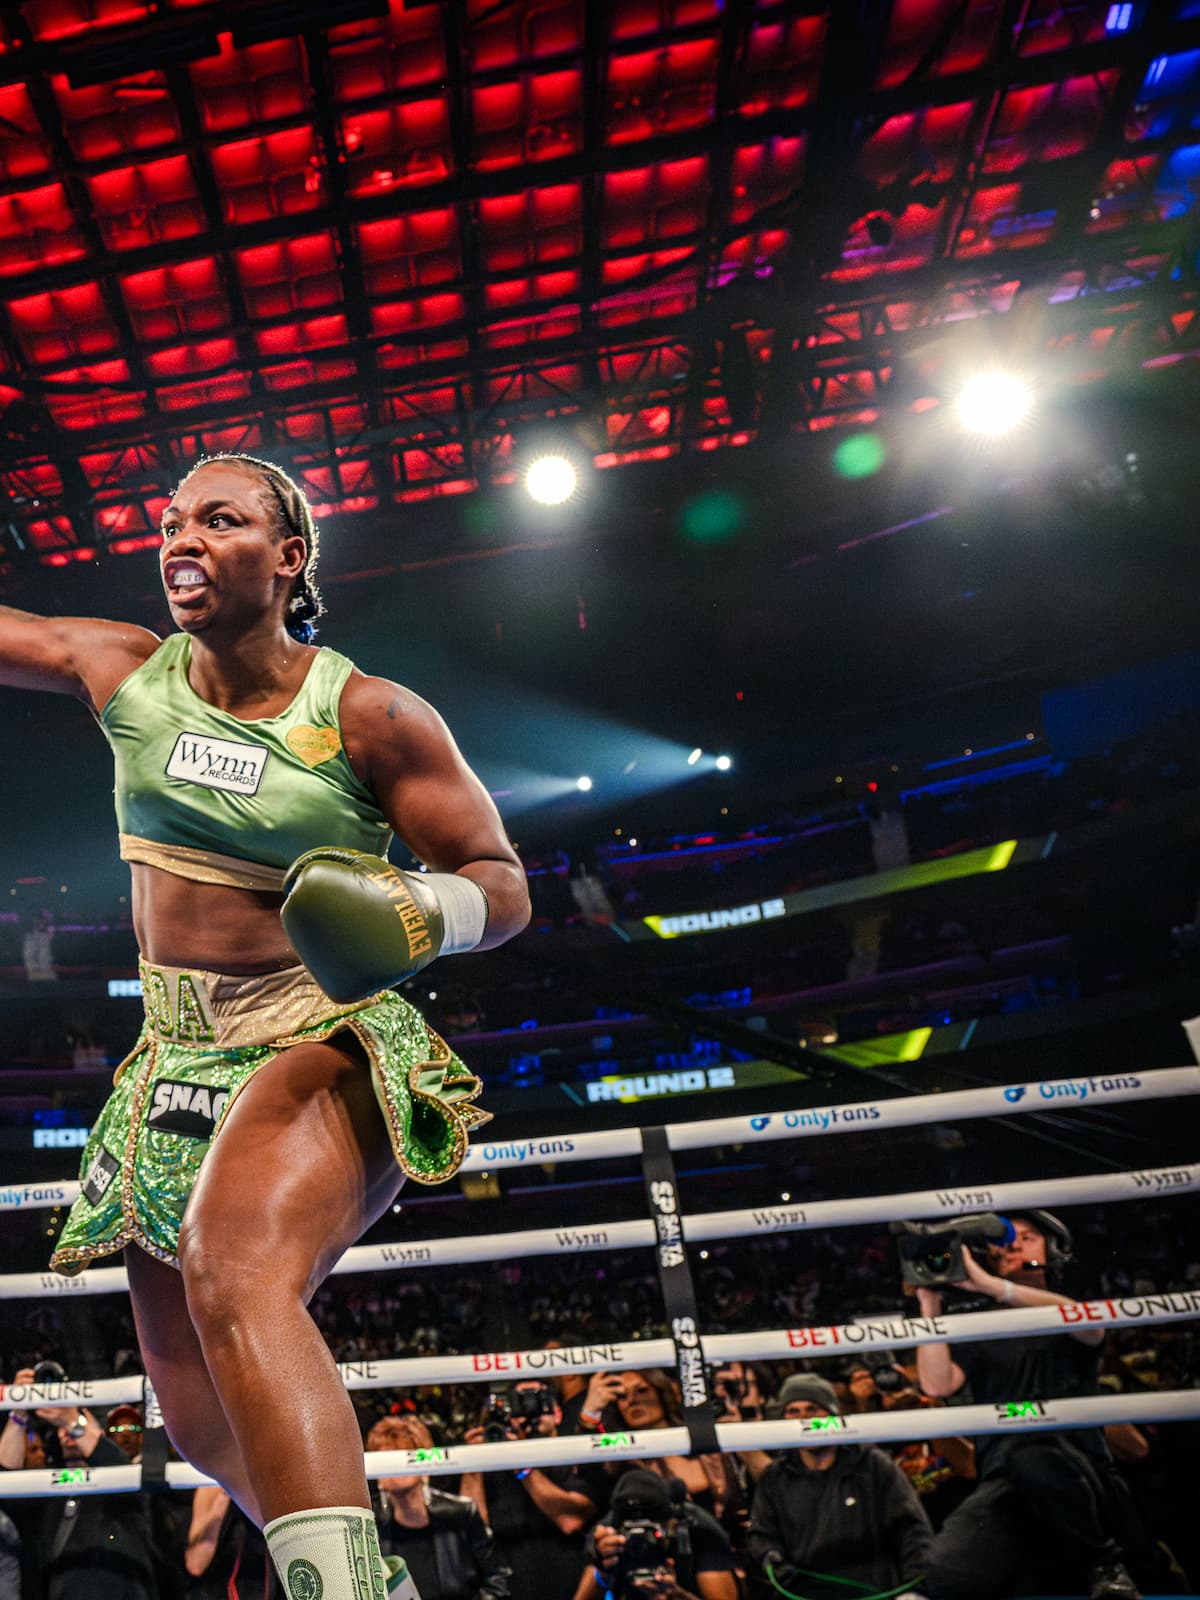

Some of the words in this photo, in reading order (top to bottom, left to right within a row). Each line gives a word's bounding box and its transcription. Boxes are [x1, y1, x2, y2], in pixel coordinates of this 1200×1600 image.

[180, 739, 259, 776] Wynn
[208, 769, 257, 787] RECORDS
[366, 869, 433, 961] EVERLAST
[661, 903, 761, 935] ROUND
[586, 1069, 706, 1103] ROUND
[706, 1066, 736, 1089] 2
[1040, 1075, 1142, 1100] OnlyFans
[783, 1104, 880, 1129] OnlyFans
[483, 1138, 575, 1161] OnlyFans
[555, 1231, 609, 1251] Wynn
[786, 1318, 948, 1348] BETONLINE
[473, 1345, 624, 1372] BETONLINE
